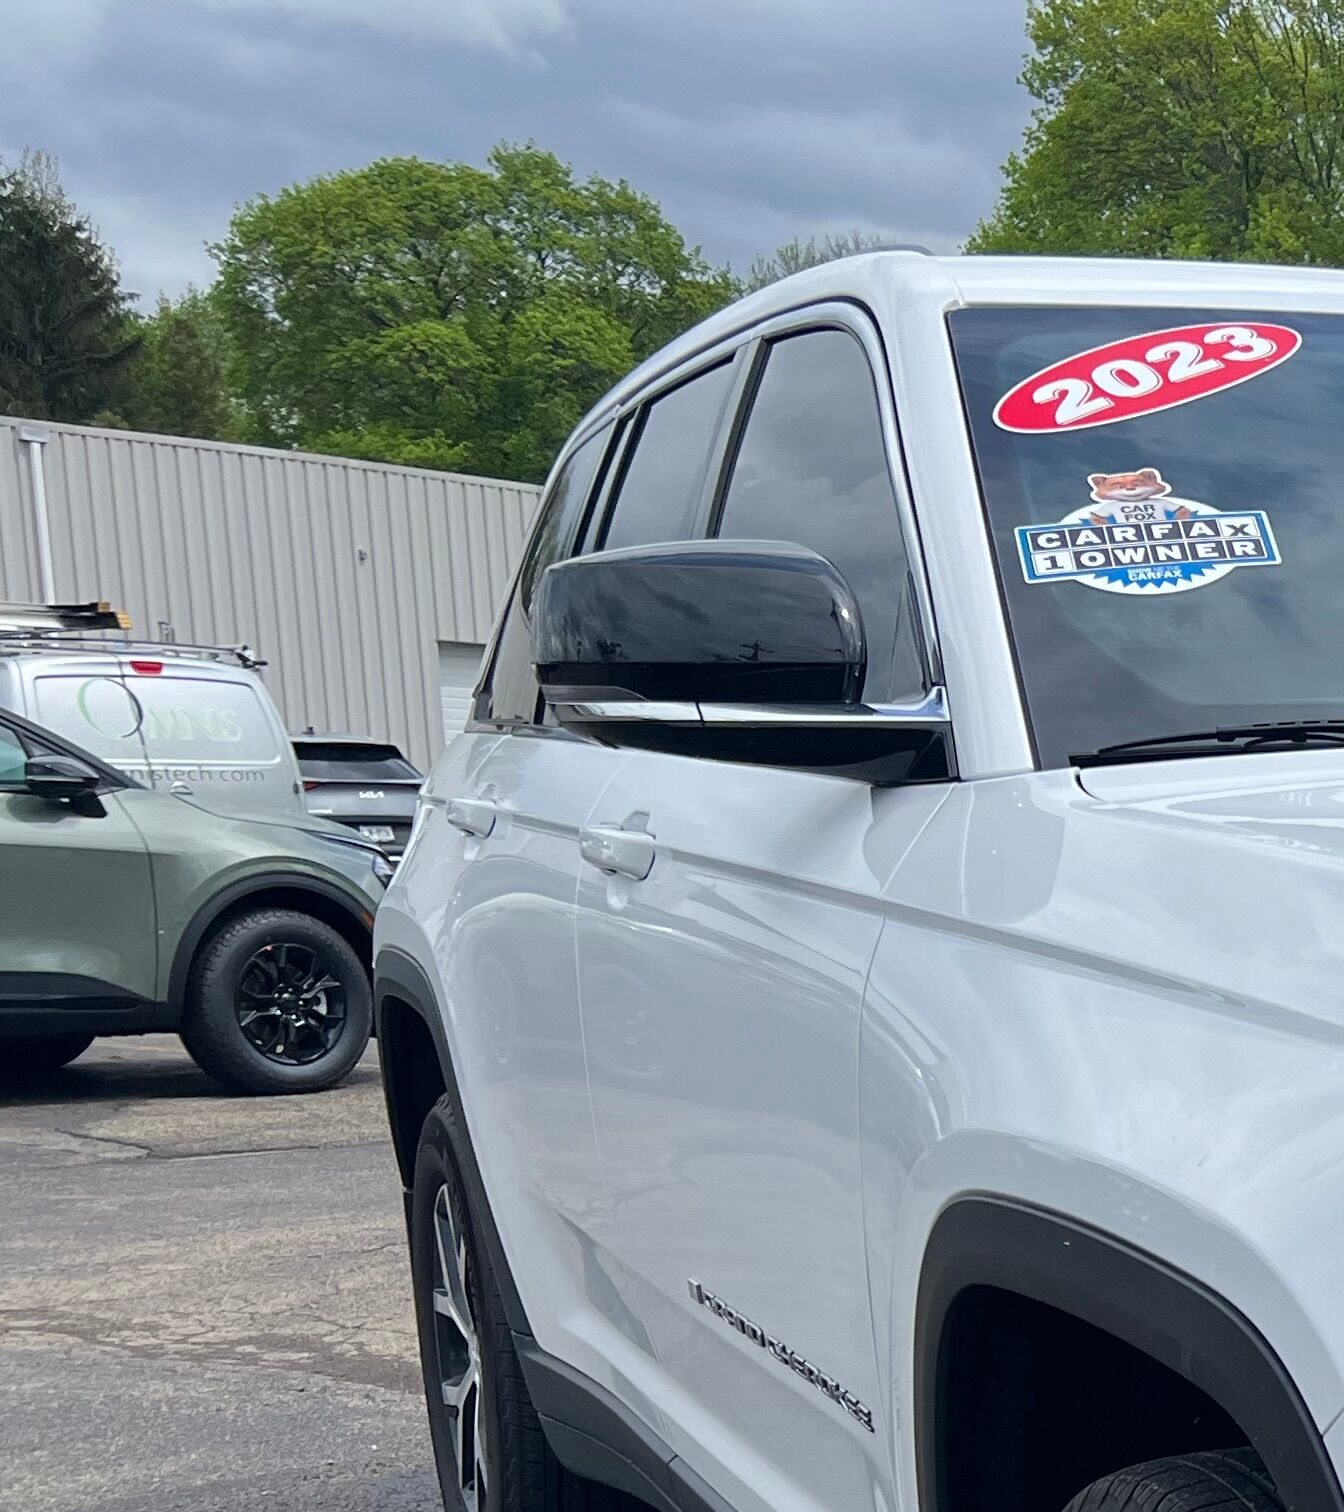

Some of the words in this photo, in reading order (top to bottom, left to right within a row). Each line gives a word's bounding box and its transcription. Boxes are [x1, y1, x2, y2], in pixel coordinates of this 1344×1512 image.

[1033, 326, 1278, 426] 2023
[1120, 503, 1156, 514] CAR
[1124, 512, 1157, 522] FOX
[1036, 519, 1260, 549] CARFAX
[1044, 552, 1065, 572] 1
[1079, 540, 1265, 569] OWNER
[1128, 569, 1183, 582] CARFAX
[119, 767, 265, 783] nistech.com
